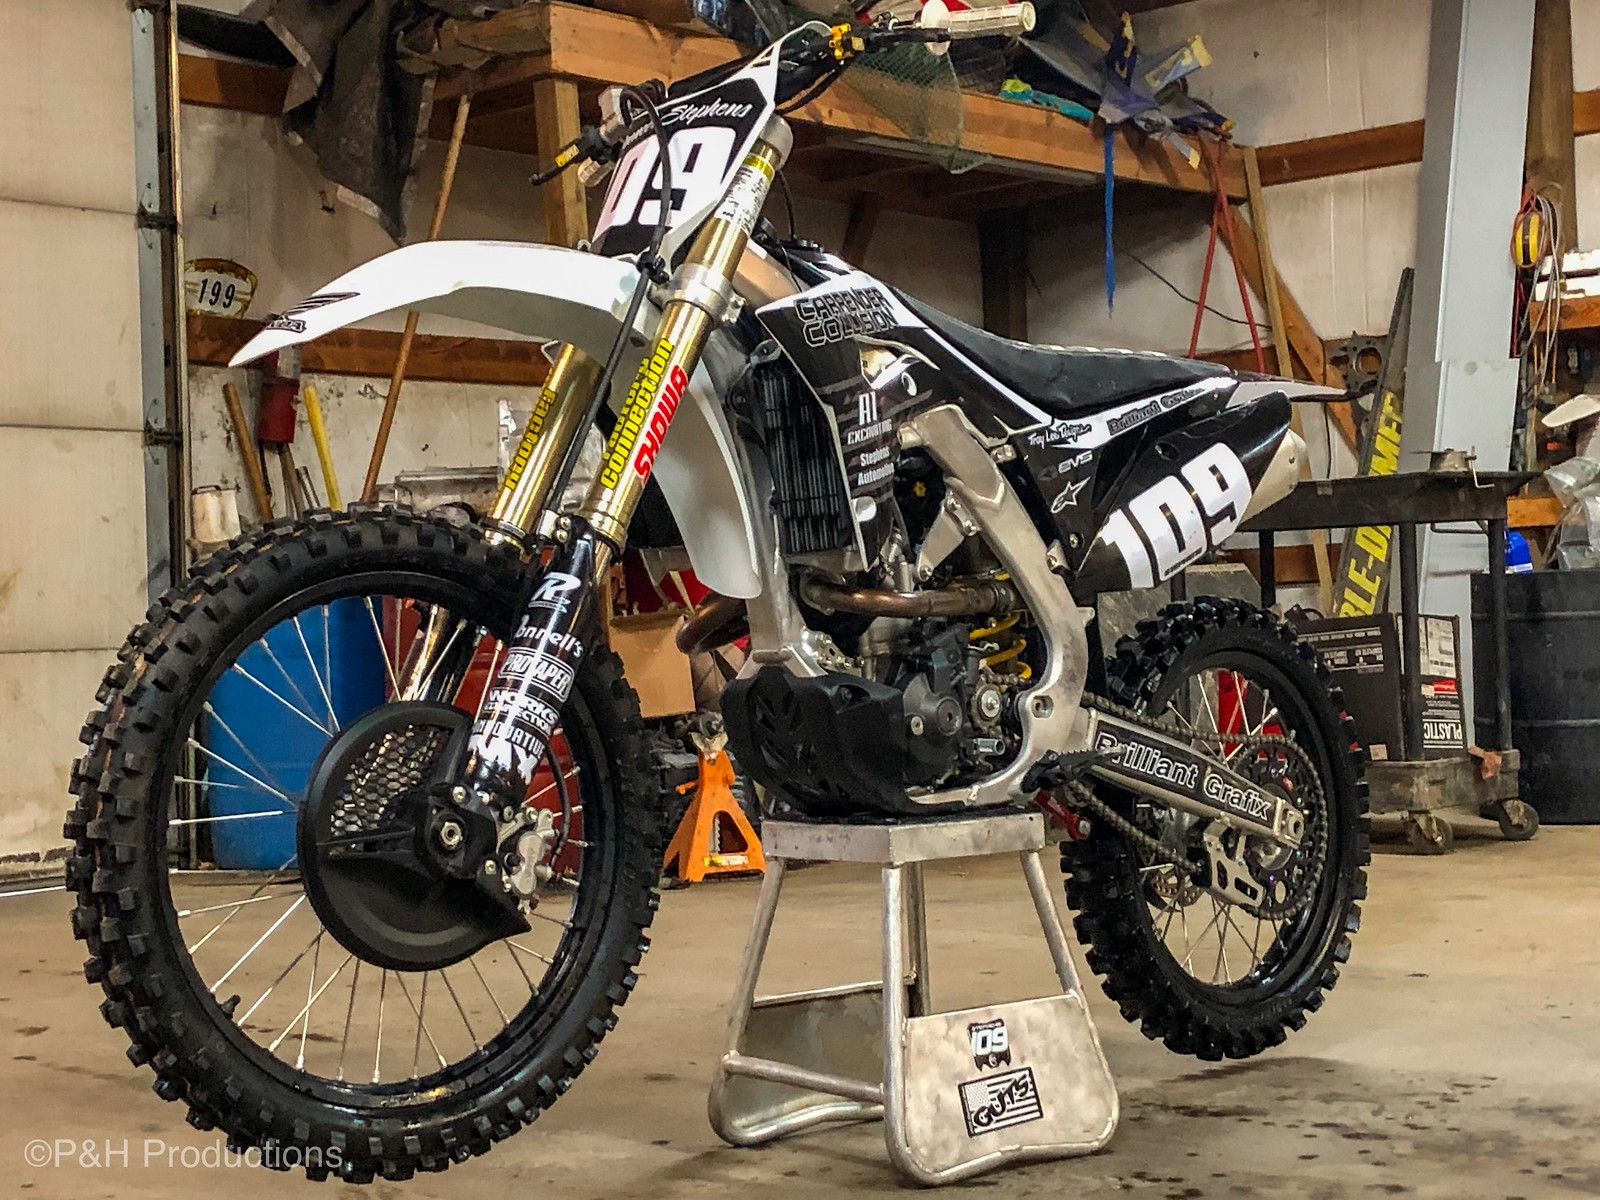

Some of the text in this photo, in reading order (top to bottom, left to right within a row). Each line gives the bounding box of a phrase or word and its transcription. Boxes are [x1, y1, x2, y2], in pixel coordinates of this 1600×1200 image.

[661, 97, 753, 125] Stephens
[197, 277, 236, 309] 199
[634, 364, 689, 487] SHOWA
[1058, 451, 1093, 474] EVS
[1097, 442, 1253, 588] 109
[1423, 722, 1463, 741] PLASTIC
[1203, 773, 1272, 821] Grafix
[973, 1073, 1029, 1128] GUTS
